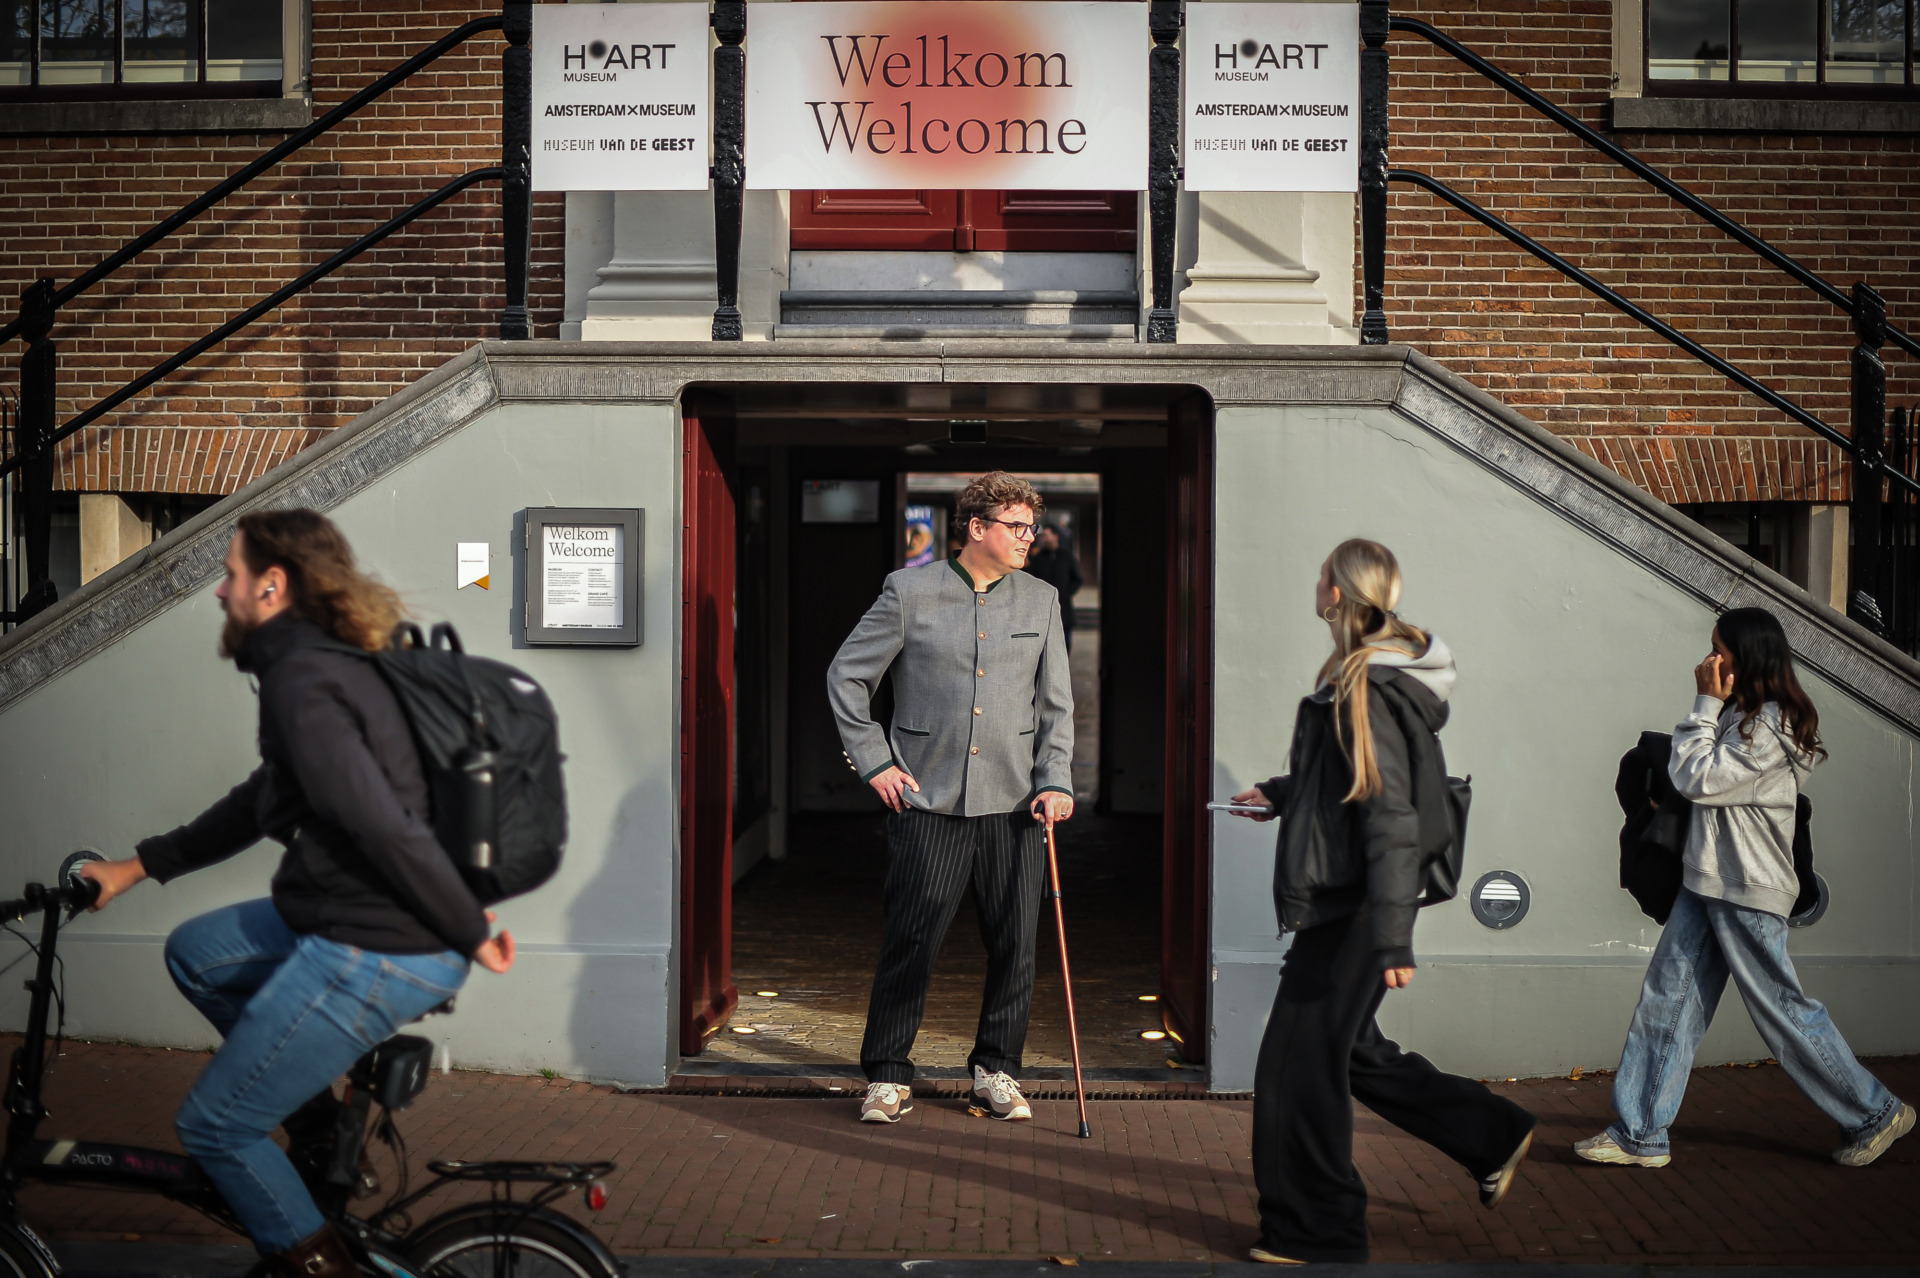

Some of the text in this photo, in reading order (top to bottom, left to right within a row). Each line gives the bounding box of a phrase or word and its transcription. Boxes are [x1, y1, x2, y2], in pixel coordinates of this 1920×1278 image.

[820, 34, 1073, 88] Welkom
[563, 72, 617, 82] MUSEUM
[1214, 72, 1269, 82] MUSEUM
[804, 100, 1087, 154] Welcome
[543, 139, 595, 151] MUSEUM
[630, 138, 647, 151] DE
[652, 138, 695, 151] GEEST
[1194, 139, 1246, 151] MUSEUM
[1282, 139, 1300, 151] DE
[1304, 139, 1348, 152] GEEST
[549, 526, 609, 541] Welkom
[548, 542, 615, 557] Welcome
[71, 1153, 113, 1166] PACTO
